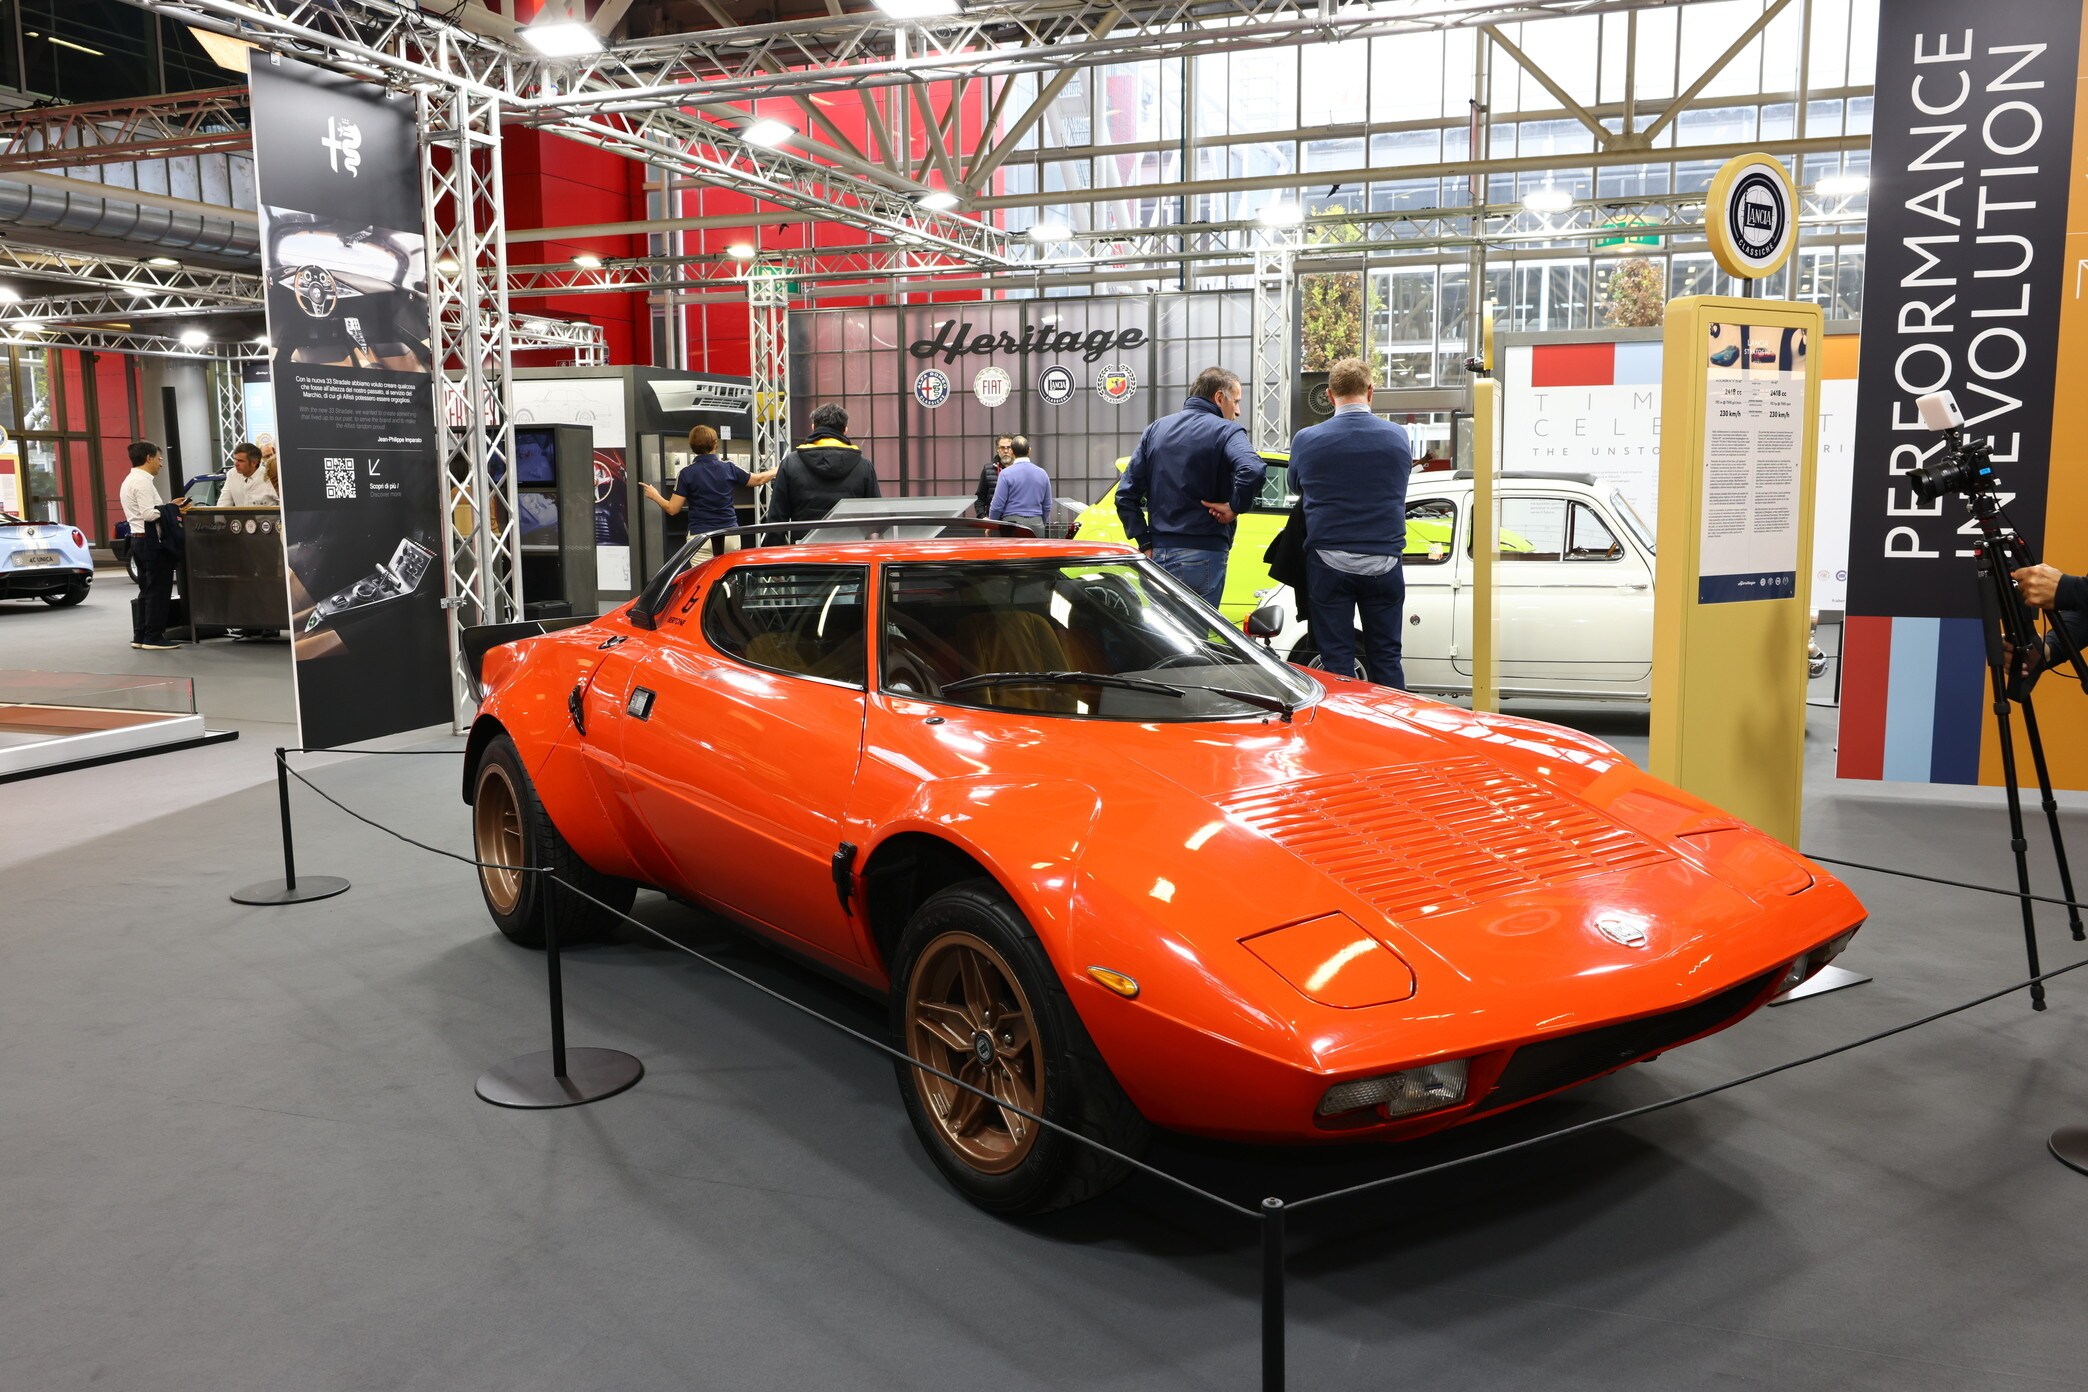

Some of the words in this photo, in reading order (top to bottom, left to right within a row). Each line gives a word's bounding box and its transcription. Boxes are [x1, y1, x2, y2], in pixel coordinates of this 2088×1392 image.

[1746, 204, 1772, 226] LANCIA
[1738, 239, 1774, 256] CLASSICHE
[1963, 43, 2048, 462] EVOLUTION
[910, 320, 1148, 364] Heritage
[918, 374, 928, 389] ALFA
[930, 372, 946, 389] ROMEO
[982, 380, 1002, 394] FIAT
[1050, 380, 1066, 391] LANCIA
[919, 395, 946, 405] CLASSICHE
[1534, 392, 1652, 411] TIM
[1729, 410, 1741, 418] km/h
[1534, 417, 1661, 437] CELE
[1533, 448, 1568, 456] THE
[1591, 446, 1660, 456] UNSTO
